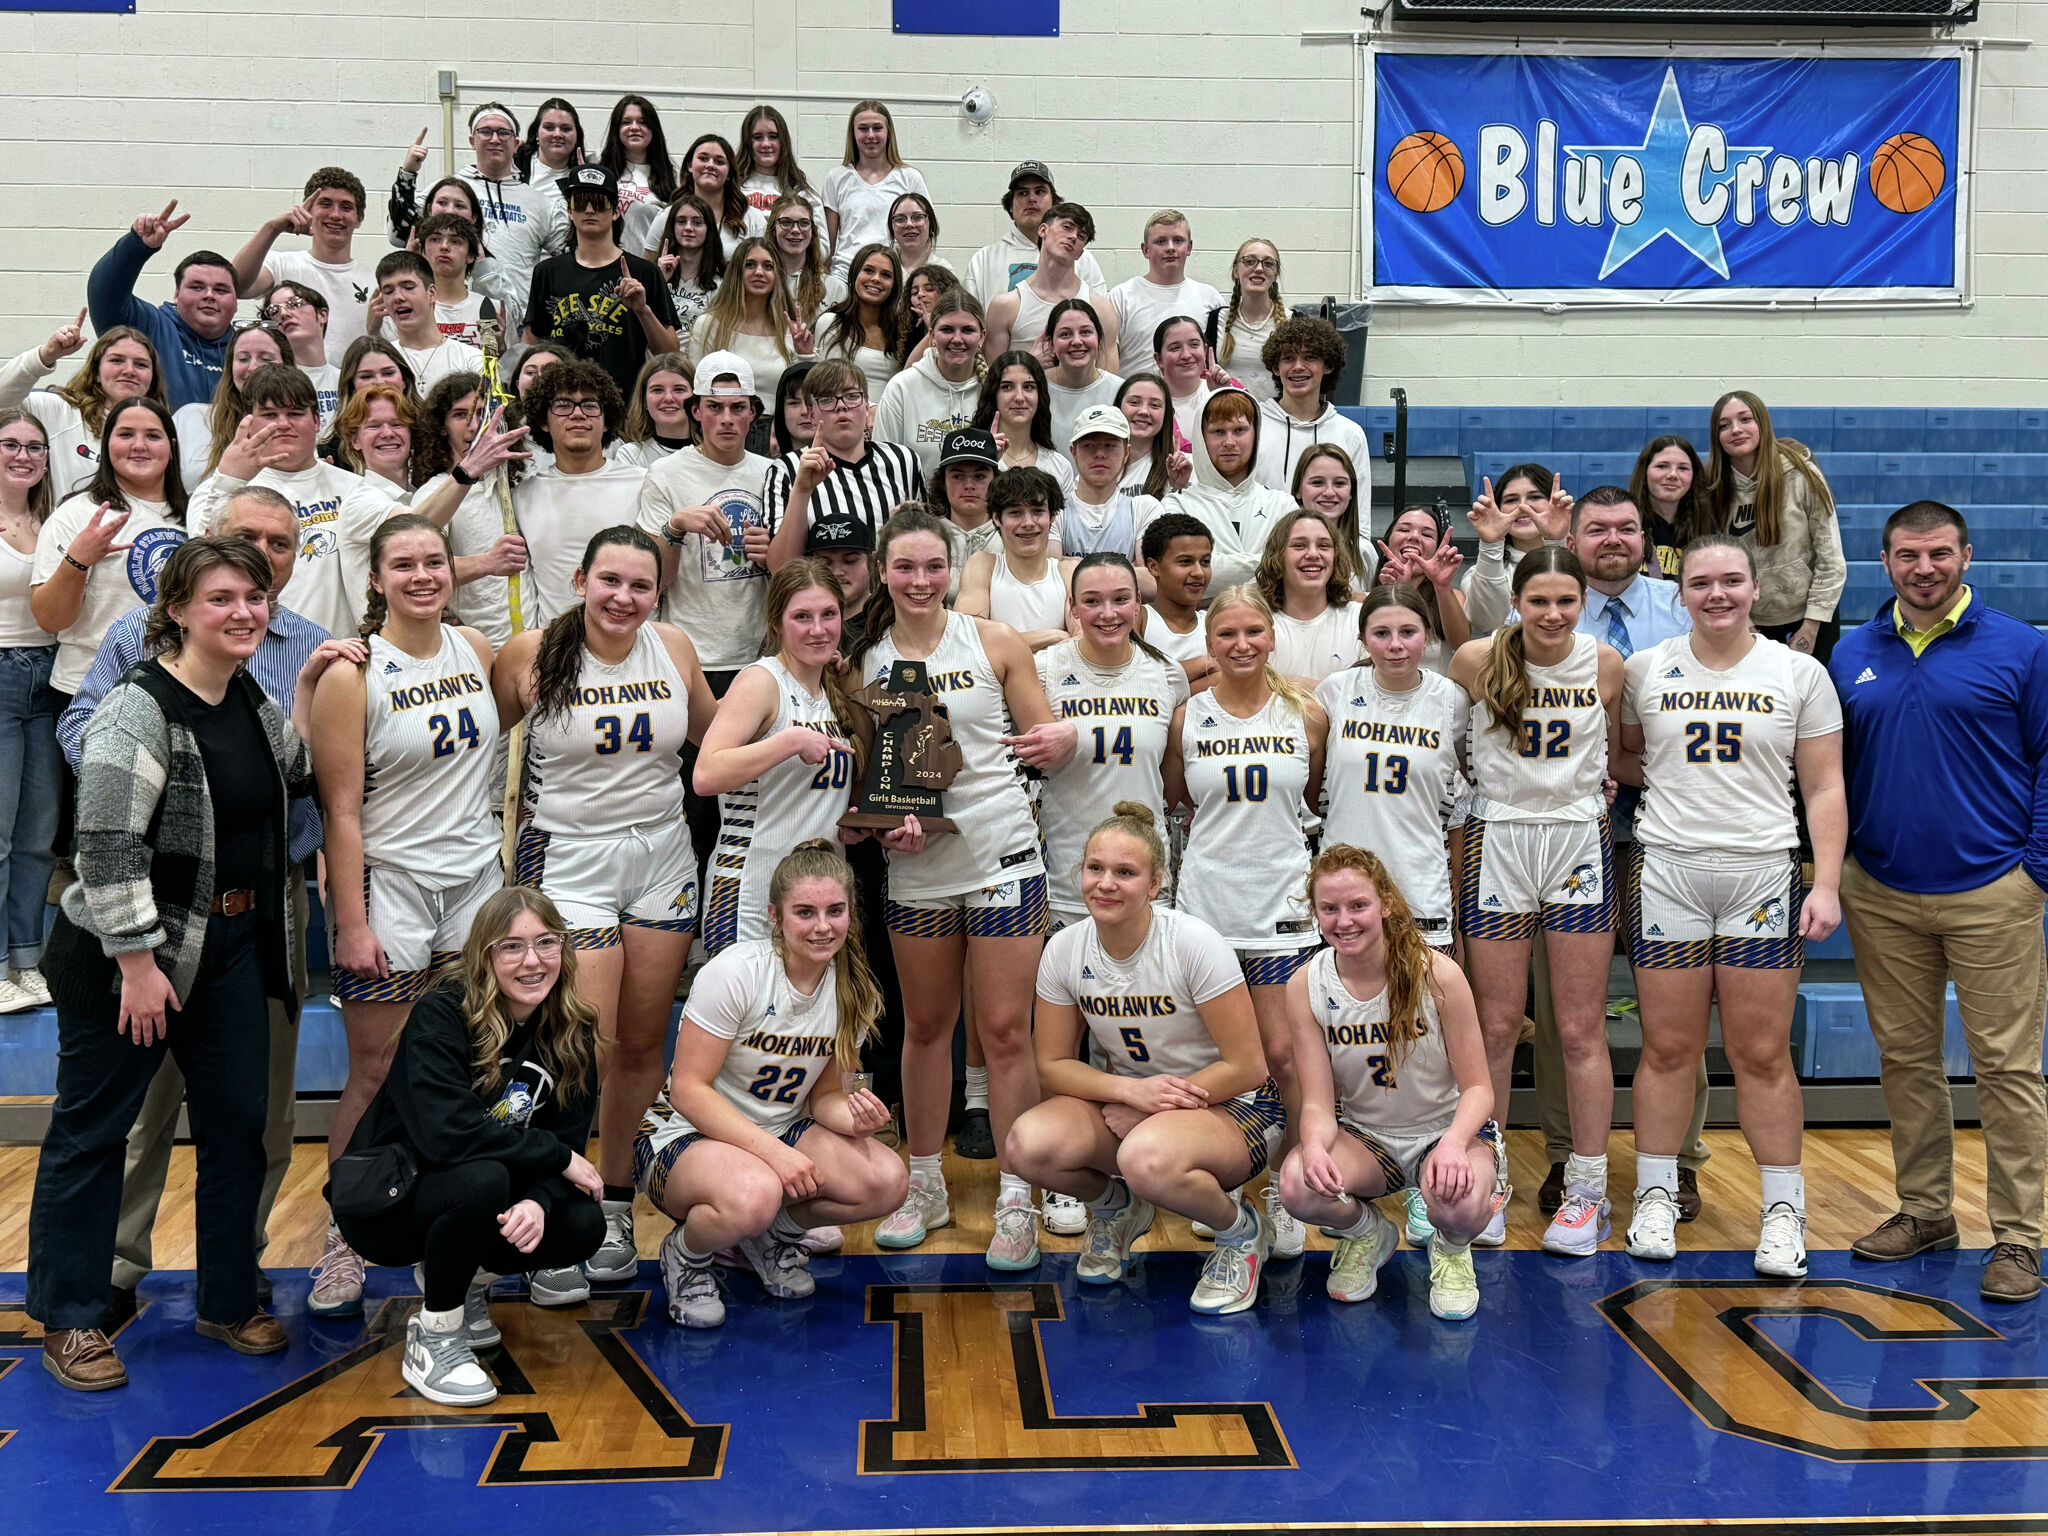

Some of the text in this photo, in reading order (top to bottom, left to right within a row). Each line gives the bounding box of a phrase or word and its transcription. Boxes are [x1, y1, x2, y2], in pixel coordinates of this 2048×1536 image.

[1477, 118, 1861, 227] Blue Crew
[587, 294, 628, 324] SEE
[952, 435, 987, 451] Good
[390, 672, 483, 712] MOHAWKS
[569, 680, 672, 708] MOHAWKS
[1060, 696, 1160, 719] MOHAWKS
[1526, 687, 1598, 709] HAWKS
[1659, 690, 1776, 715] MOHAWKS
[426, 705, 481, 760] 24
[594, 711, 656, 757] 34
[1090, 725, 1136, 767] 14
[1196, 735, 1297, 759] MOHAWKS
[1341, 719, 1441, 750] MOHAWKS
[1518, 717, 1573, 761] 32
[1684, 720, 1745, 765] 25
[880, 731, 895, 790] CHAMPION
[915, 770, 942, 779] 2024
[1363, 750, 1411, 797] 13
[869, 793, 936, 806] Girls Basketball
[1222, 762, 1270, 804] 10
[1080, 994, 1178, 1018] MOHAWKS
[740, 1031, 836, 1058] MOHAWKS
[1118, 1026, 1151, 1065] 5
[748, 1064, 809, 1107] 22
